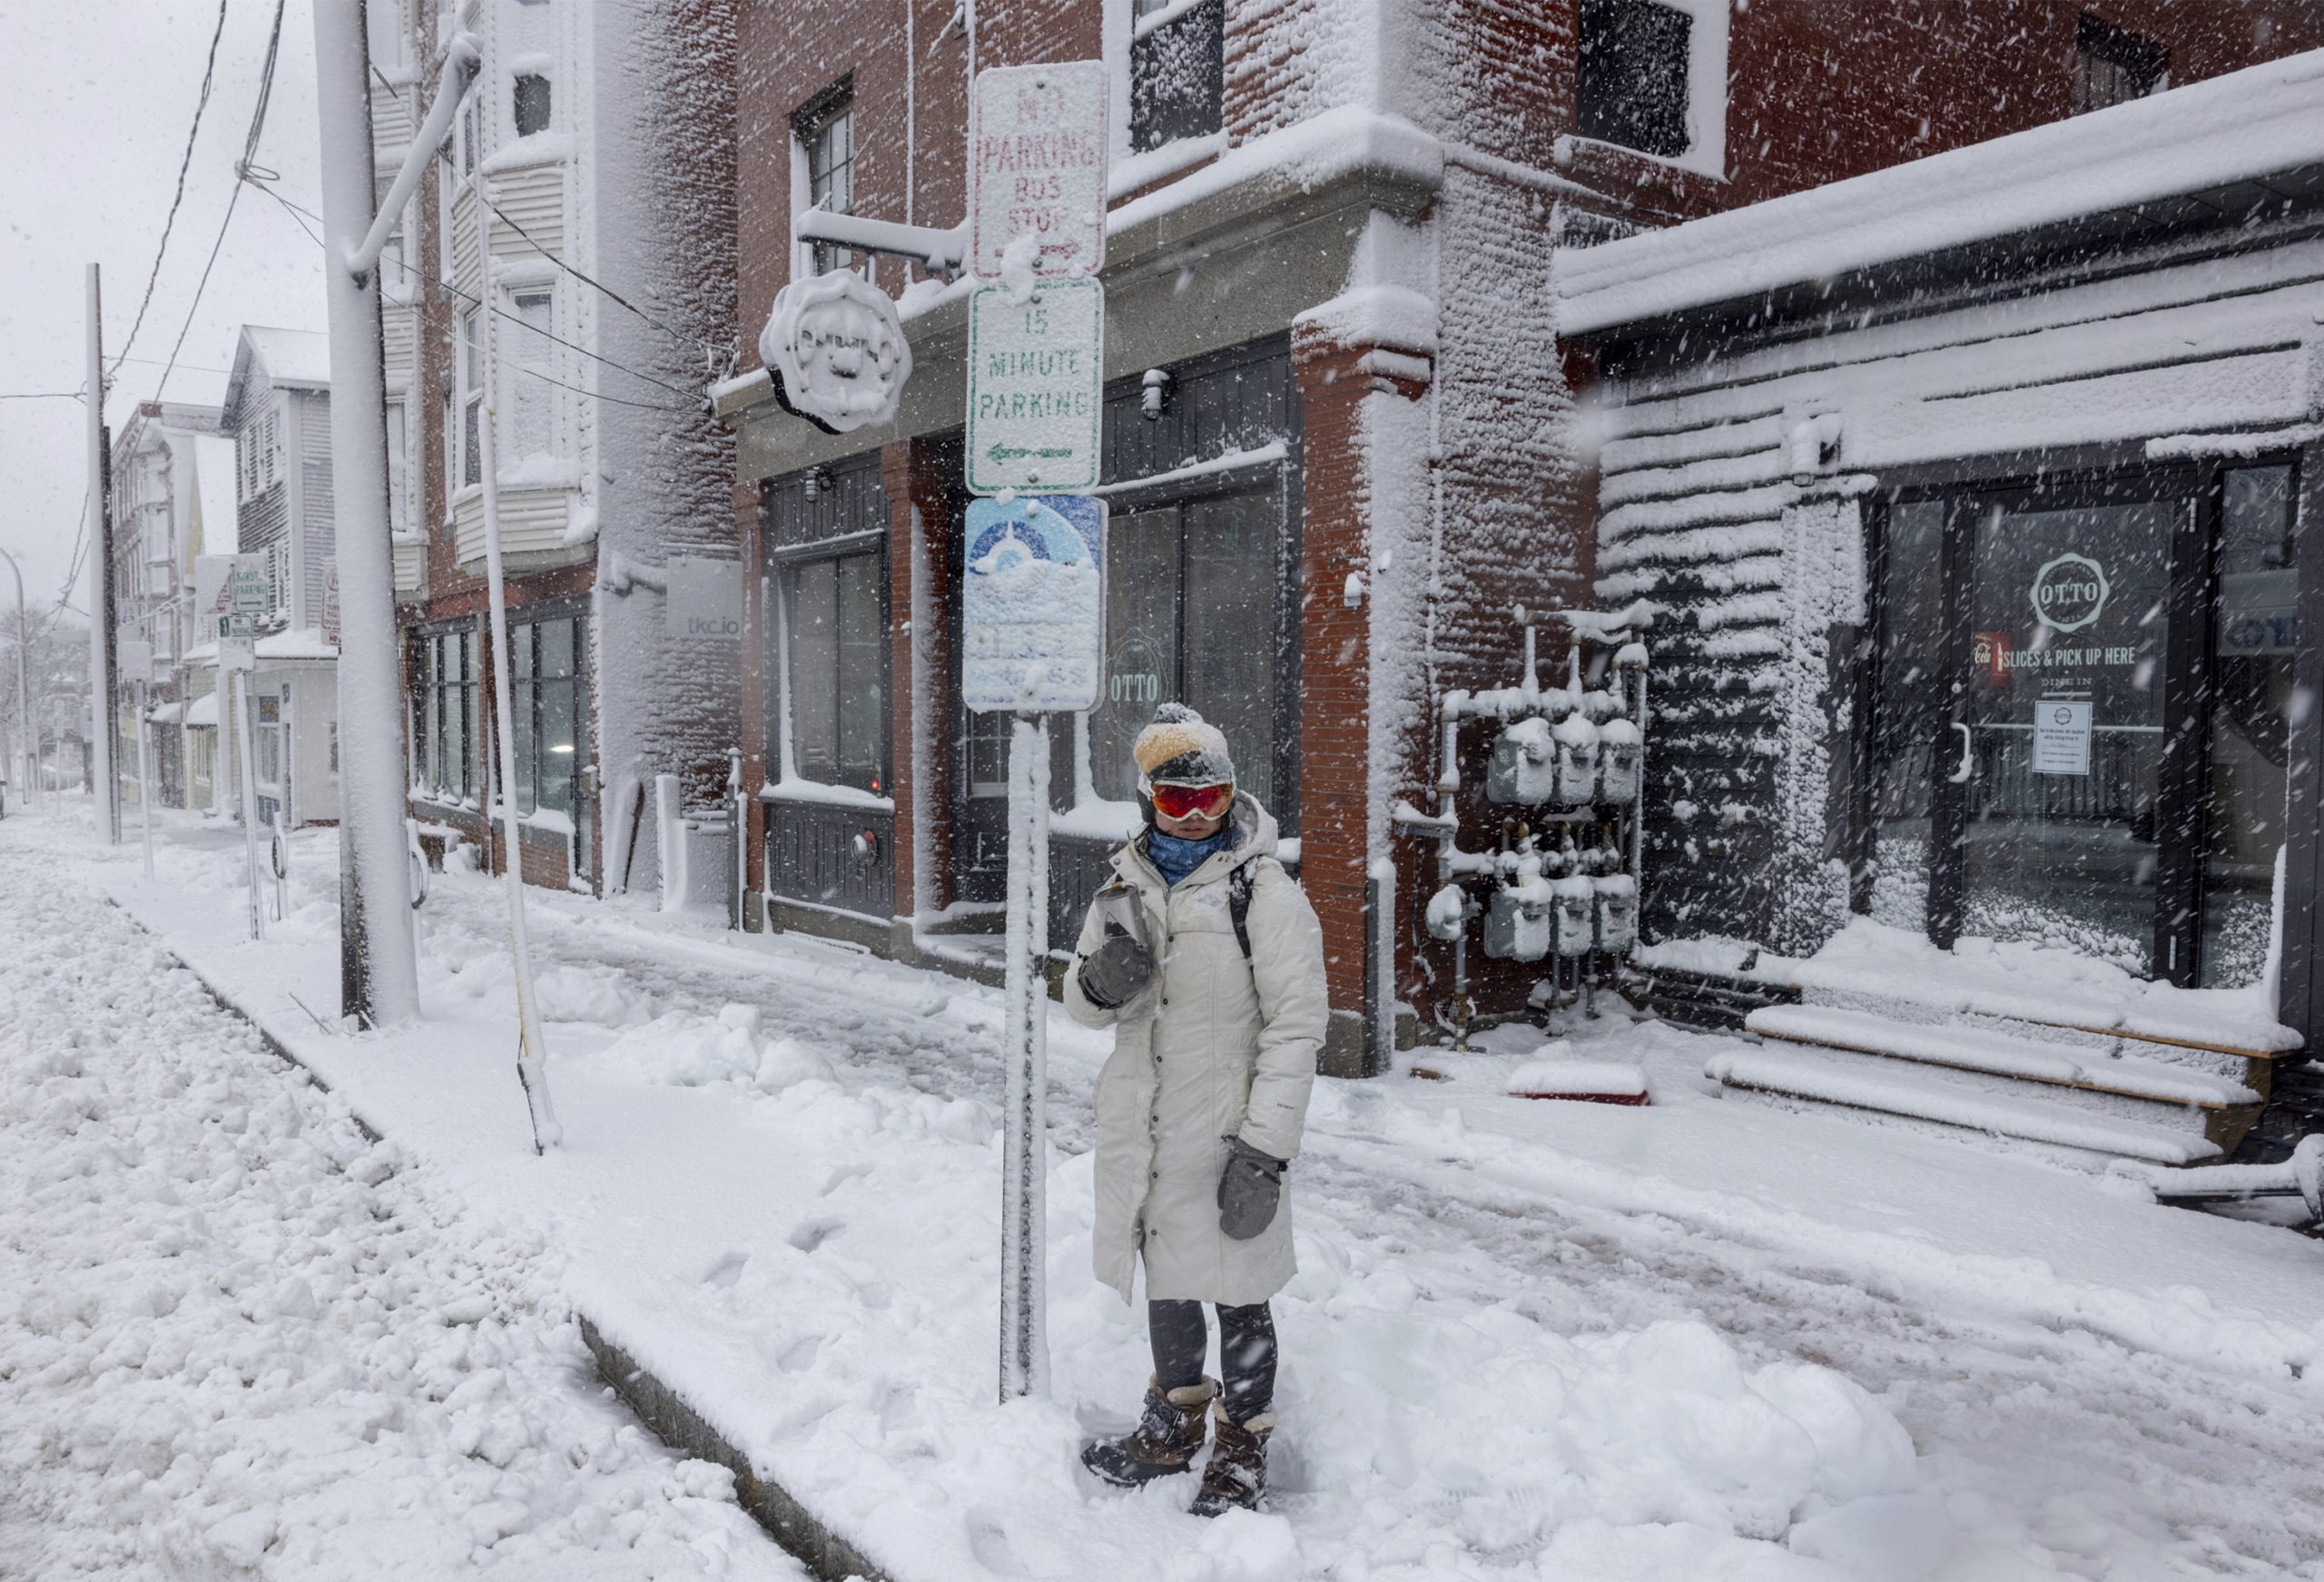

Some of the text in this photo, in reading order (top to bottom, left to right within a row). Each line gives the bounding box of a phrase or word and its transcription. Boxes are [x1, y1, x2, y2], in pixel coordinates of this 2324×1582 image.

[984, 130, 1095, 173] PARKING
[1015, 175, 1061, 202] BUS
[1025, 310, 1049, 334] 15
[990, 349, 1082, 378] MINUTE
[980, 391, 1088, 419] PARKING
[2040, 582, 2098, 604] OTTO
[688, 616, 739, 635] tkc.io
[2003, 646, 2136, 668] SLICES & PICK UP HERE
[1110, 673, 1158, 703] OTTO
[2041, 677, 2093, 686] DINE IN
